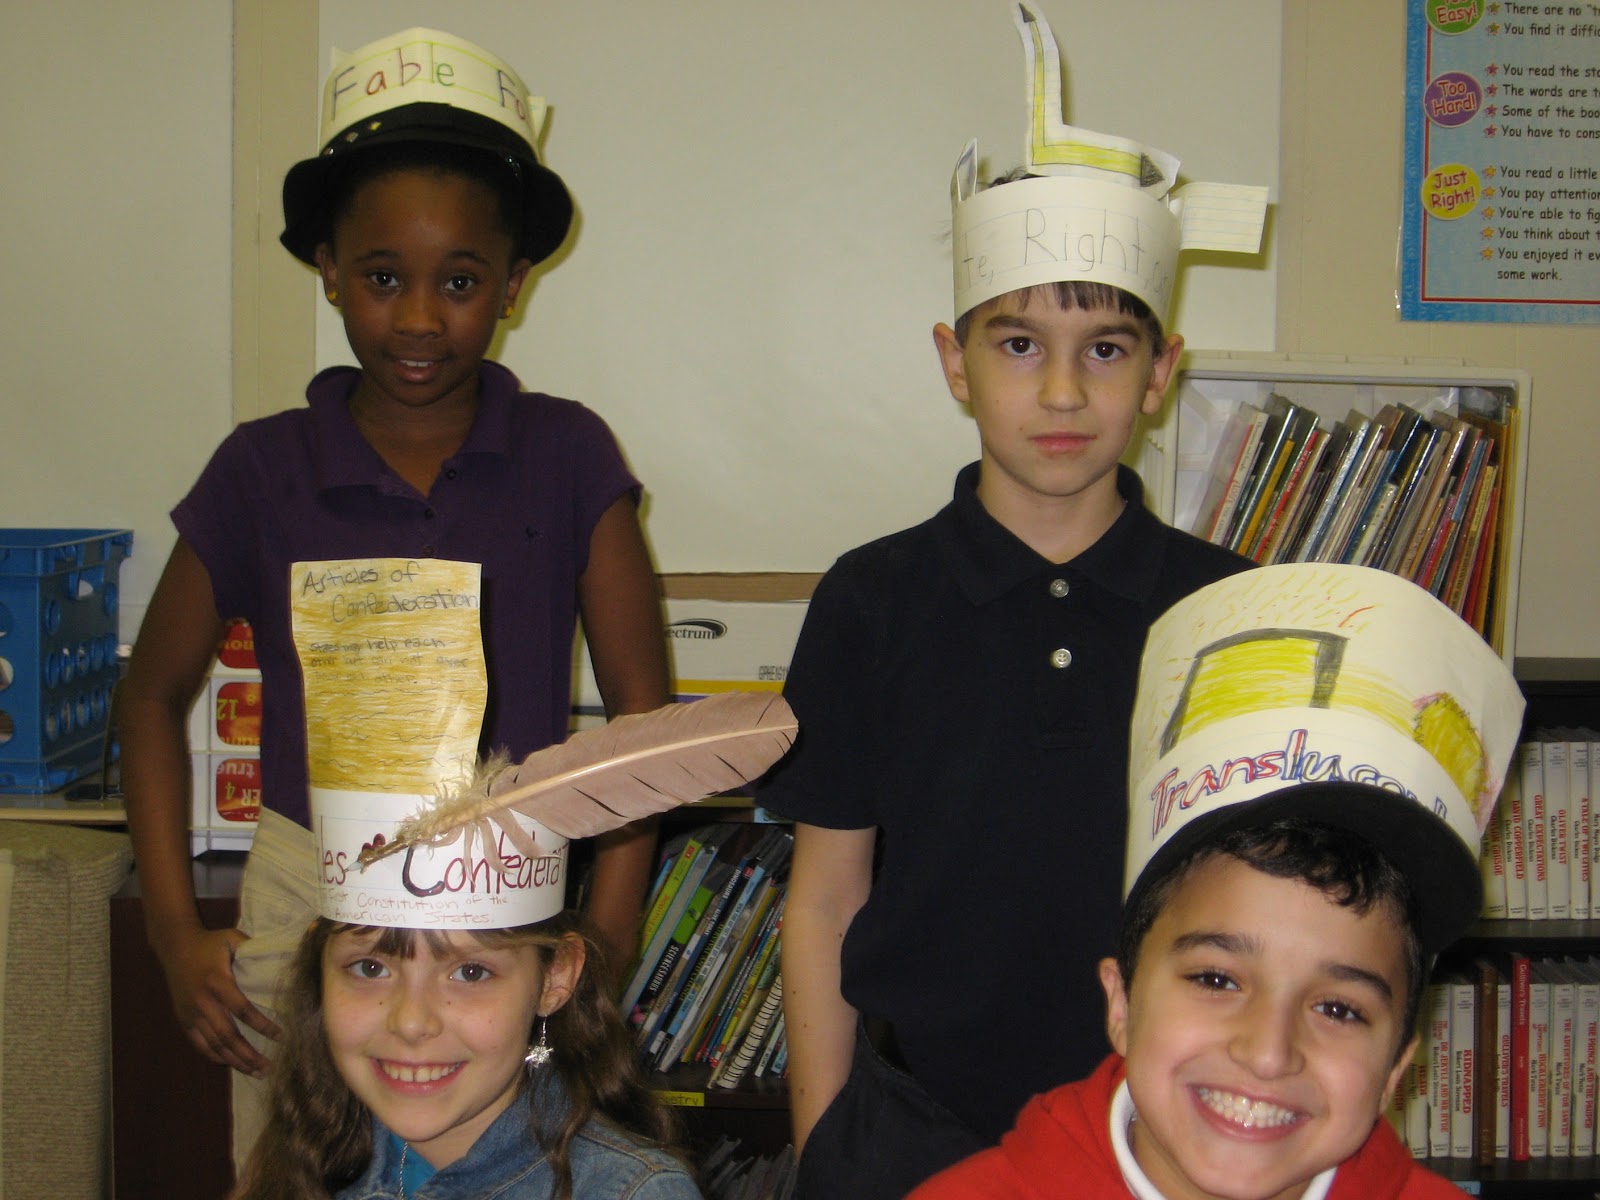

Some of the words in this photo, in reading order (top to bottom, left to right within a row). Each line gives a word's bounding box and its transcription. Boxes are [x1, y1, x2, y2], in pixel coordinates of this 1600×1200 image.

[1436, 2, 1478, 24] Easy!
[1504, 2, 1539, 15] There
[1544, 6, 1564, 15] are
[1569, 6, 1582, 16] no
[1504, 23, 1524, 35] You
[1530, 23, 1551, 36] find
[1556, 24, 1565, 36] it
[1502, 64, 1523, 76] You
[1528, 65, 1554, 77] read
[1560, 66, 1579, 78] the
[331, 43, 455, 121] Fable
[1437, 80, 1467, 97] Too
[1502, 85, 1524, 97] The
[1529, 85, 1563, 97] words
[1568, 88, 1588, 98] are
[1592, 86, 1600, 98] t
[1432, 92, 1477, 117] Hard!
[1502, 106, 1532, 118] Some
[1538, 105, 1550, 118] of
[1556, 106, 1576, 118] the
[1501, 125, 1522, 138] You
[1527, 125, 1553, 138] have
[1559, 127, 1571, 139] to
[1433, 170, 1468, 189] Just
[1500, 167, 1521, 179] You
[1526, 167, 1552, 179] read
[1557, 170, 1564, 179] a
[1569, 167, 1598, 180] little
[1431, 186, 1476, 210] Right!
[1500, 187, 1520, 199] You
[1525, 190, 1545, 202] pay
[1499, 207, 1534, 220] You're
[1539, 207, 1563, 220] able
[1569, 209, 1581, 220] to
[1498, 227, 1519, 240] You
[1523, 228, 1552, 240] think
[1558, 229, 1590, 241] about
[1498, 248, 1518, 260] You
[1523, 248, 1568, 263] enjoyed
[1574, 249, 1583, 261] it
[1497, 271, 1526, 281] some
[1531, 269, 1562, 281] work.
[303, 565, 379, 597] Articles
[391, 561, 420, 583] of
[332, 588, 480, 623] Confederation
[665, 628, 716, 640] ectrum
[367, 636, 398, 652] help
[404, 637, 446, 648] each
[1512, 800, 1521, 824] DAVID
[1534, 794, 1543, 821] GREAT
[1558, 809, 1566, 839] OLIVER
[1582, 825, 1589, 836] OF
[1491, 845, 1504, 876] CRUSOE
[1513, 826, 1524, 880] COPPERFIELD
[1536, 824, 1546, 882] EXPECTATIONS
[1559, 841, 1567, 865] TWIST
[722, 868, 742, 900] DINOSAURS
[465, 895, 482, 905] of
[489, 895, 508, 906] the
[335, 908, 406, 923] American
[1519, 964, 1528, 1000] Gulliver's
[1519, 1000, 1527, 1026] Travels
[1564, 1018, 1572, 1032] THE
[1588, 1021, 1596, 1037] THE
[1501, 1034, 1510, 1076] GULLIVER'S
[1563, 1034, 1571, 1080] ADVENTURES
[1587, 1038, 1596, 1065] PRINCE
[1440, 1053, 1448, 1081] JEKYLL
[1586, 1066, 1595, 1083] AND
[1440, 1083, 1448, 1098] AND
[1462, 1049, 1472, 1114] KIDNAPPED
[1538, 1053, 1547, 1109] HUCKLEBERRY
[1563, 1081, 1571, 1091] OF
[671, 1095, 699, 1106] etry
[1501, 1076, 1509, 1108] TRAVELS
[1562, 1093, 1570, 1109] TOM
[1586, 1084, 1594, 1099] THE
[1440, 1112, 1448, 1133] HYDE
[1538, 1109, 1546, 1128] FINN
[1561, 1110, 1569, 1137] SAWYER
[1584, 1100, 1593, 1129] PAUPER
